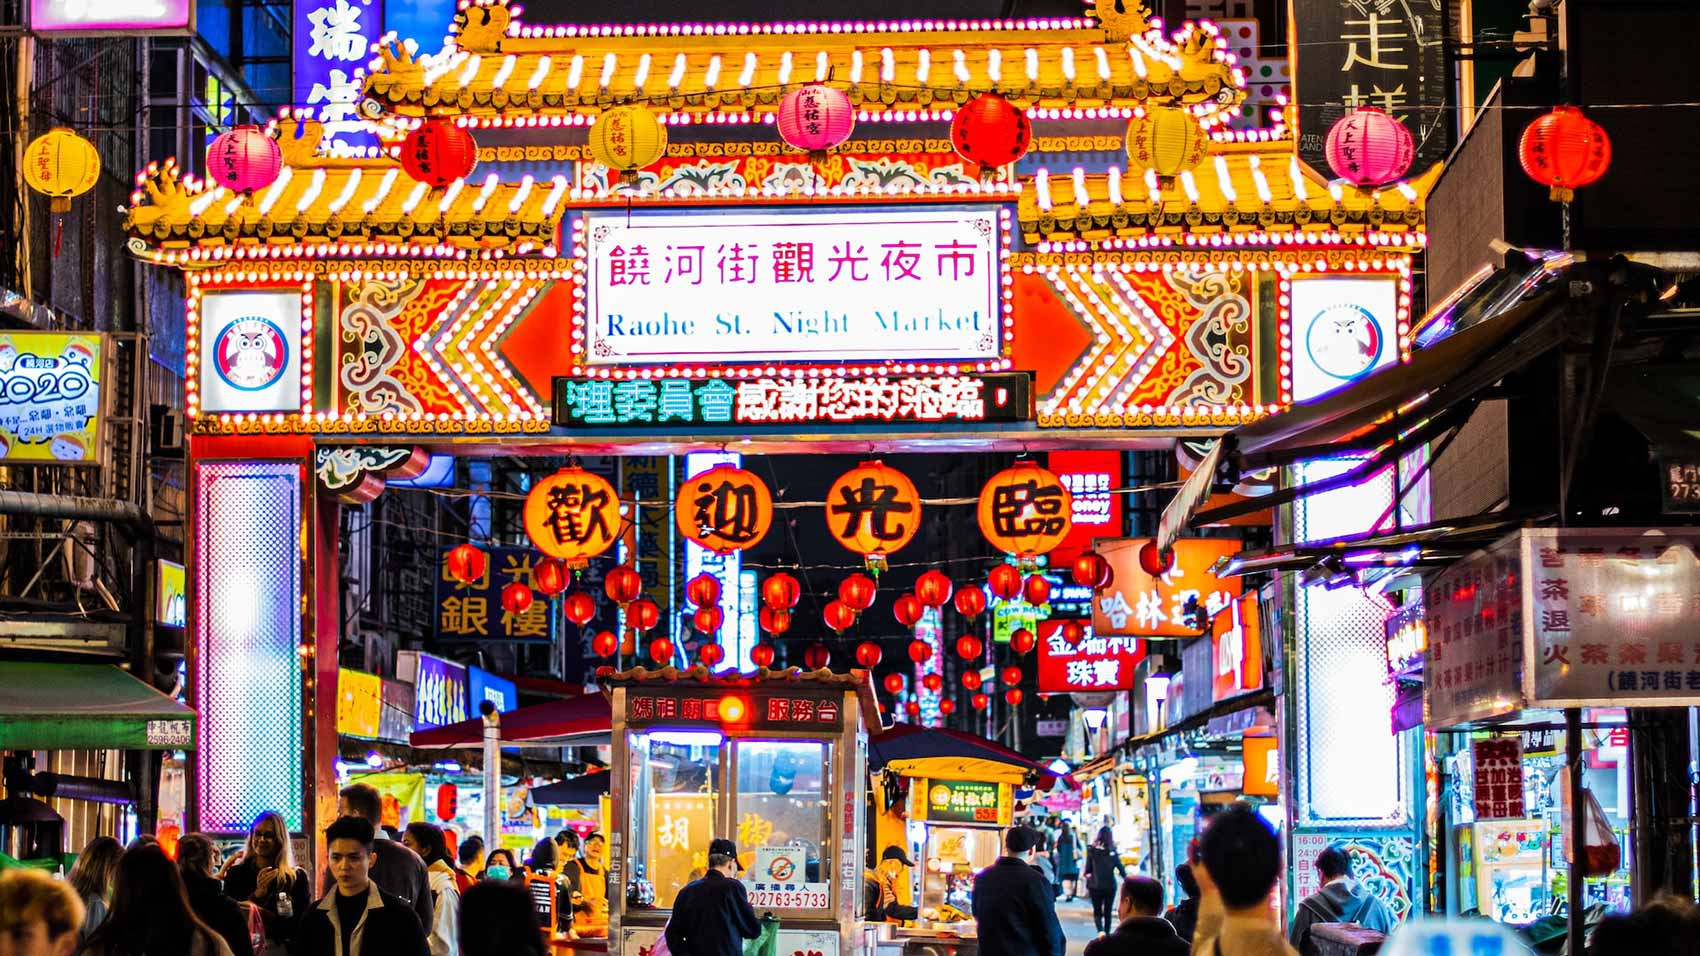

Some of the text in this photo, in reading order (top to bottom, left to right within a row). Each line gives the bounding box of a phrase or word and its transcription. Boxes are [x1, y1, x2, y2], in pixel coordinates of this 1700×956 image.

[609, 239, 978, 287] 饒河街觀光夜市
[607, 308, 981, 337] Raohe St. Night Market
[543, 484, 610, 545] 歡
[694, 480, 760, 543] 迎
[831, 478, 913, 541] 光
[993, 480, 1065, 537] 臨
[768, 698, 838, 721] 服務台
[658, 814, 689, 850] 胡
